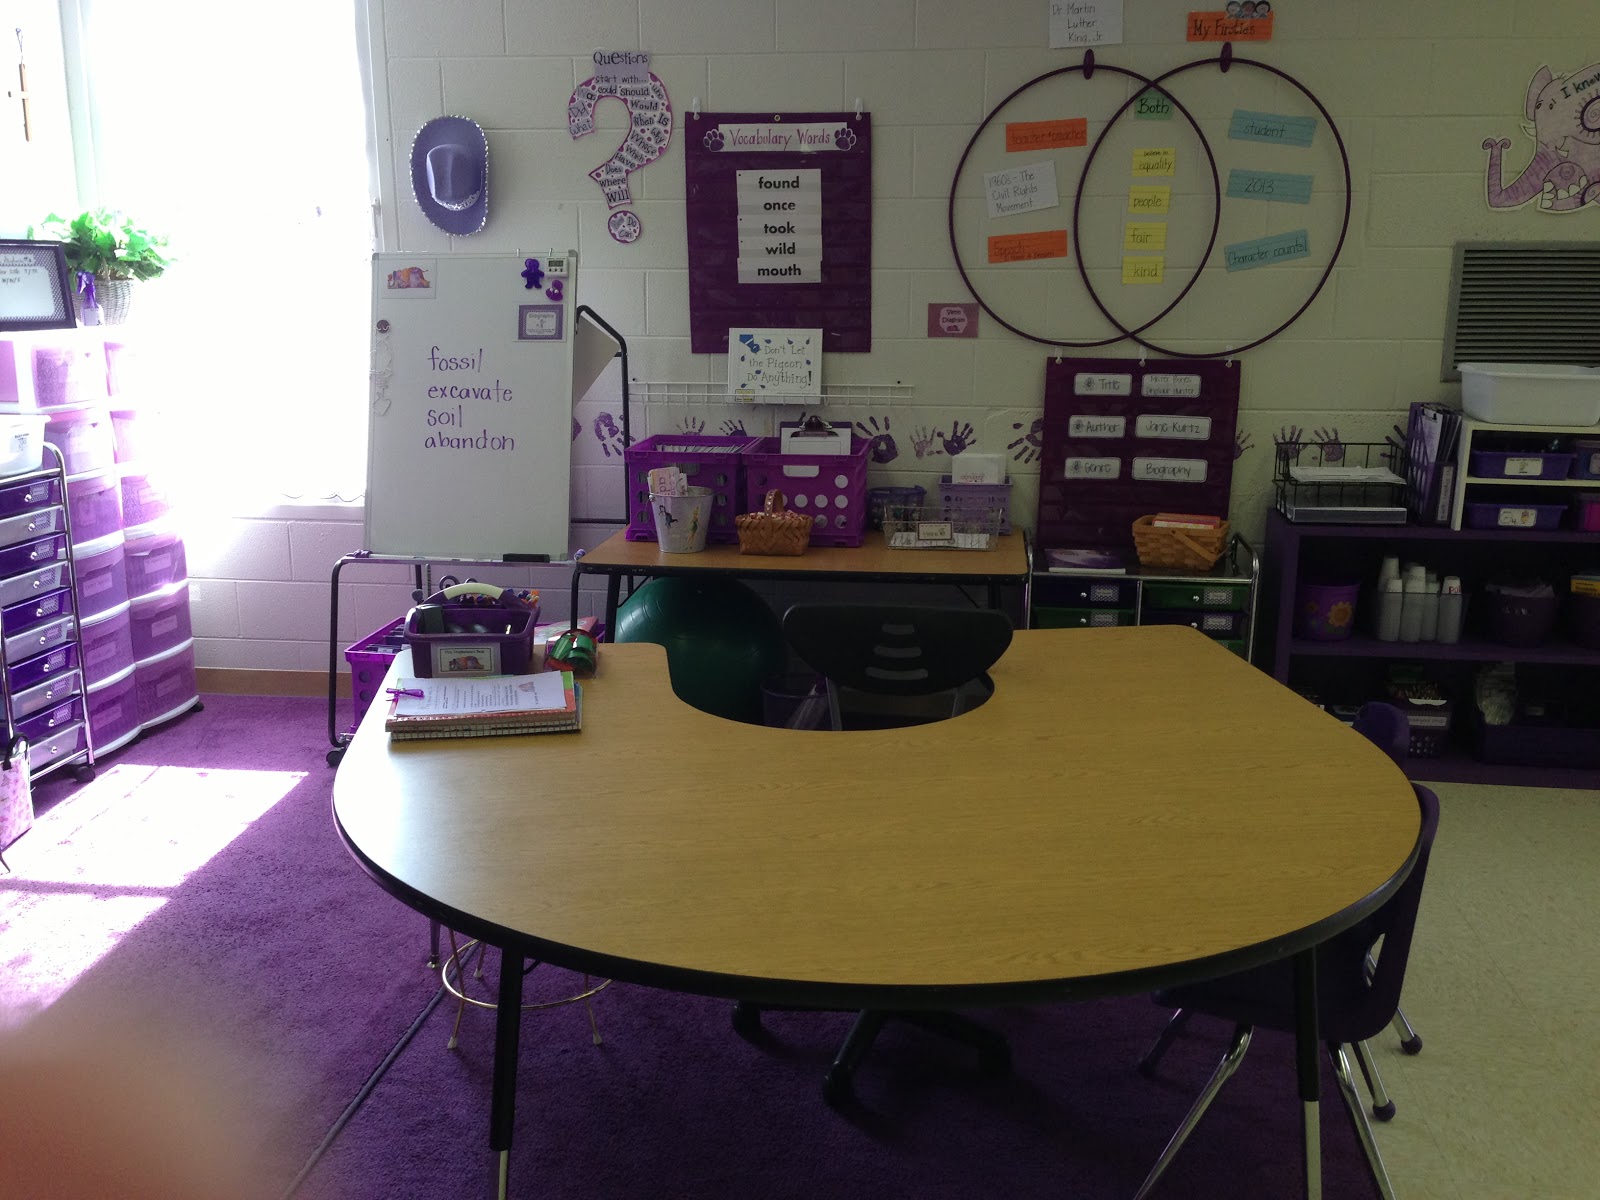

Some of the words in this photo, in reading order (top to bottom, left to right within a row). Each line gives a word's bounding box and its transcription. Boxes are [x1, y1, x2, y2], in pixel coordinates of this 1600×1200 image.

[1067, 3, 1096, 15] Martin
[1067, 19, 1096, 30] Luther
[1193, 19, 1210, 40] My
[1214, 17, 1256, 36] Firsties
[593, 51, 649, 64] Questions
[595, 75, 617, 84] start
[1560, 86, 1571, 99] I
[569, 102, 588, 118] Did
[630, 101, 659, 112] Would
[1137, 98, 1169, 114] Both
[633, 115, 655, 127] When
[657, 113, 670, 127] Is
[1243, 122, 1287, 138] student
[729, 129, 792, 151] Vocabulary
[797, 128, 831, 145] Words
[615, 152, 636, 169] Have
[626, 145, 645, 163] Which
[605, 164, 622, 174] Does
[1138, 157, 1173, 171] equality
[599, 177, 627, 188] Where
[758, 176, 800, 190] found
[1020, 170, 1036, 182] The
[991, 189, 1010, 201] Civil
[1013, 182, 1038, 197] Rights
[1244, 178, 1275, 195] 2013
[606, 189, 630, 203] Will
[1133, 195, 1162, 208] people
[763, 202, 796, 211] once
[995, 199, 1034, 214] Movement
[627, 216, 637, 227] Do
[763, 221, 796, 234] took
[619, 229, 632, 239] Can
[1130, 229, 1151, 244] fair
[765, 243, 796, 255] wild
[757, 264, 802, 276] mouth
[1132, 263, 1158, 278] kind
[764, 345, 786, 355] Don't
[791, 345, 806, 355] Let
[427, 345, 483, 373] fossil
[749, 358, 764, 368] the
[767, 357, 803, 374] Pigeon
[747, 373, 758, 382] Do
[761, 370, 812, 389] Anything!
[427, 379, 513, 403] excavate
[427, 404, 463, 428] soil
[1086, 421, 1120, 434] Author
[1145, 420, 1169, 433] Jane
[1172, 422, 1200, 434] Kurtz
[424, 429, 515, 451] abandon
[1084, 463, 1112, 474] Genre
[1146, 463, 1191, 478] Biography
